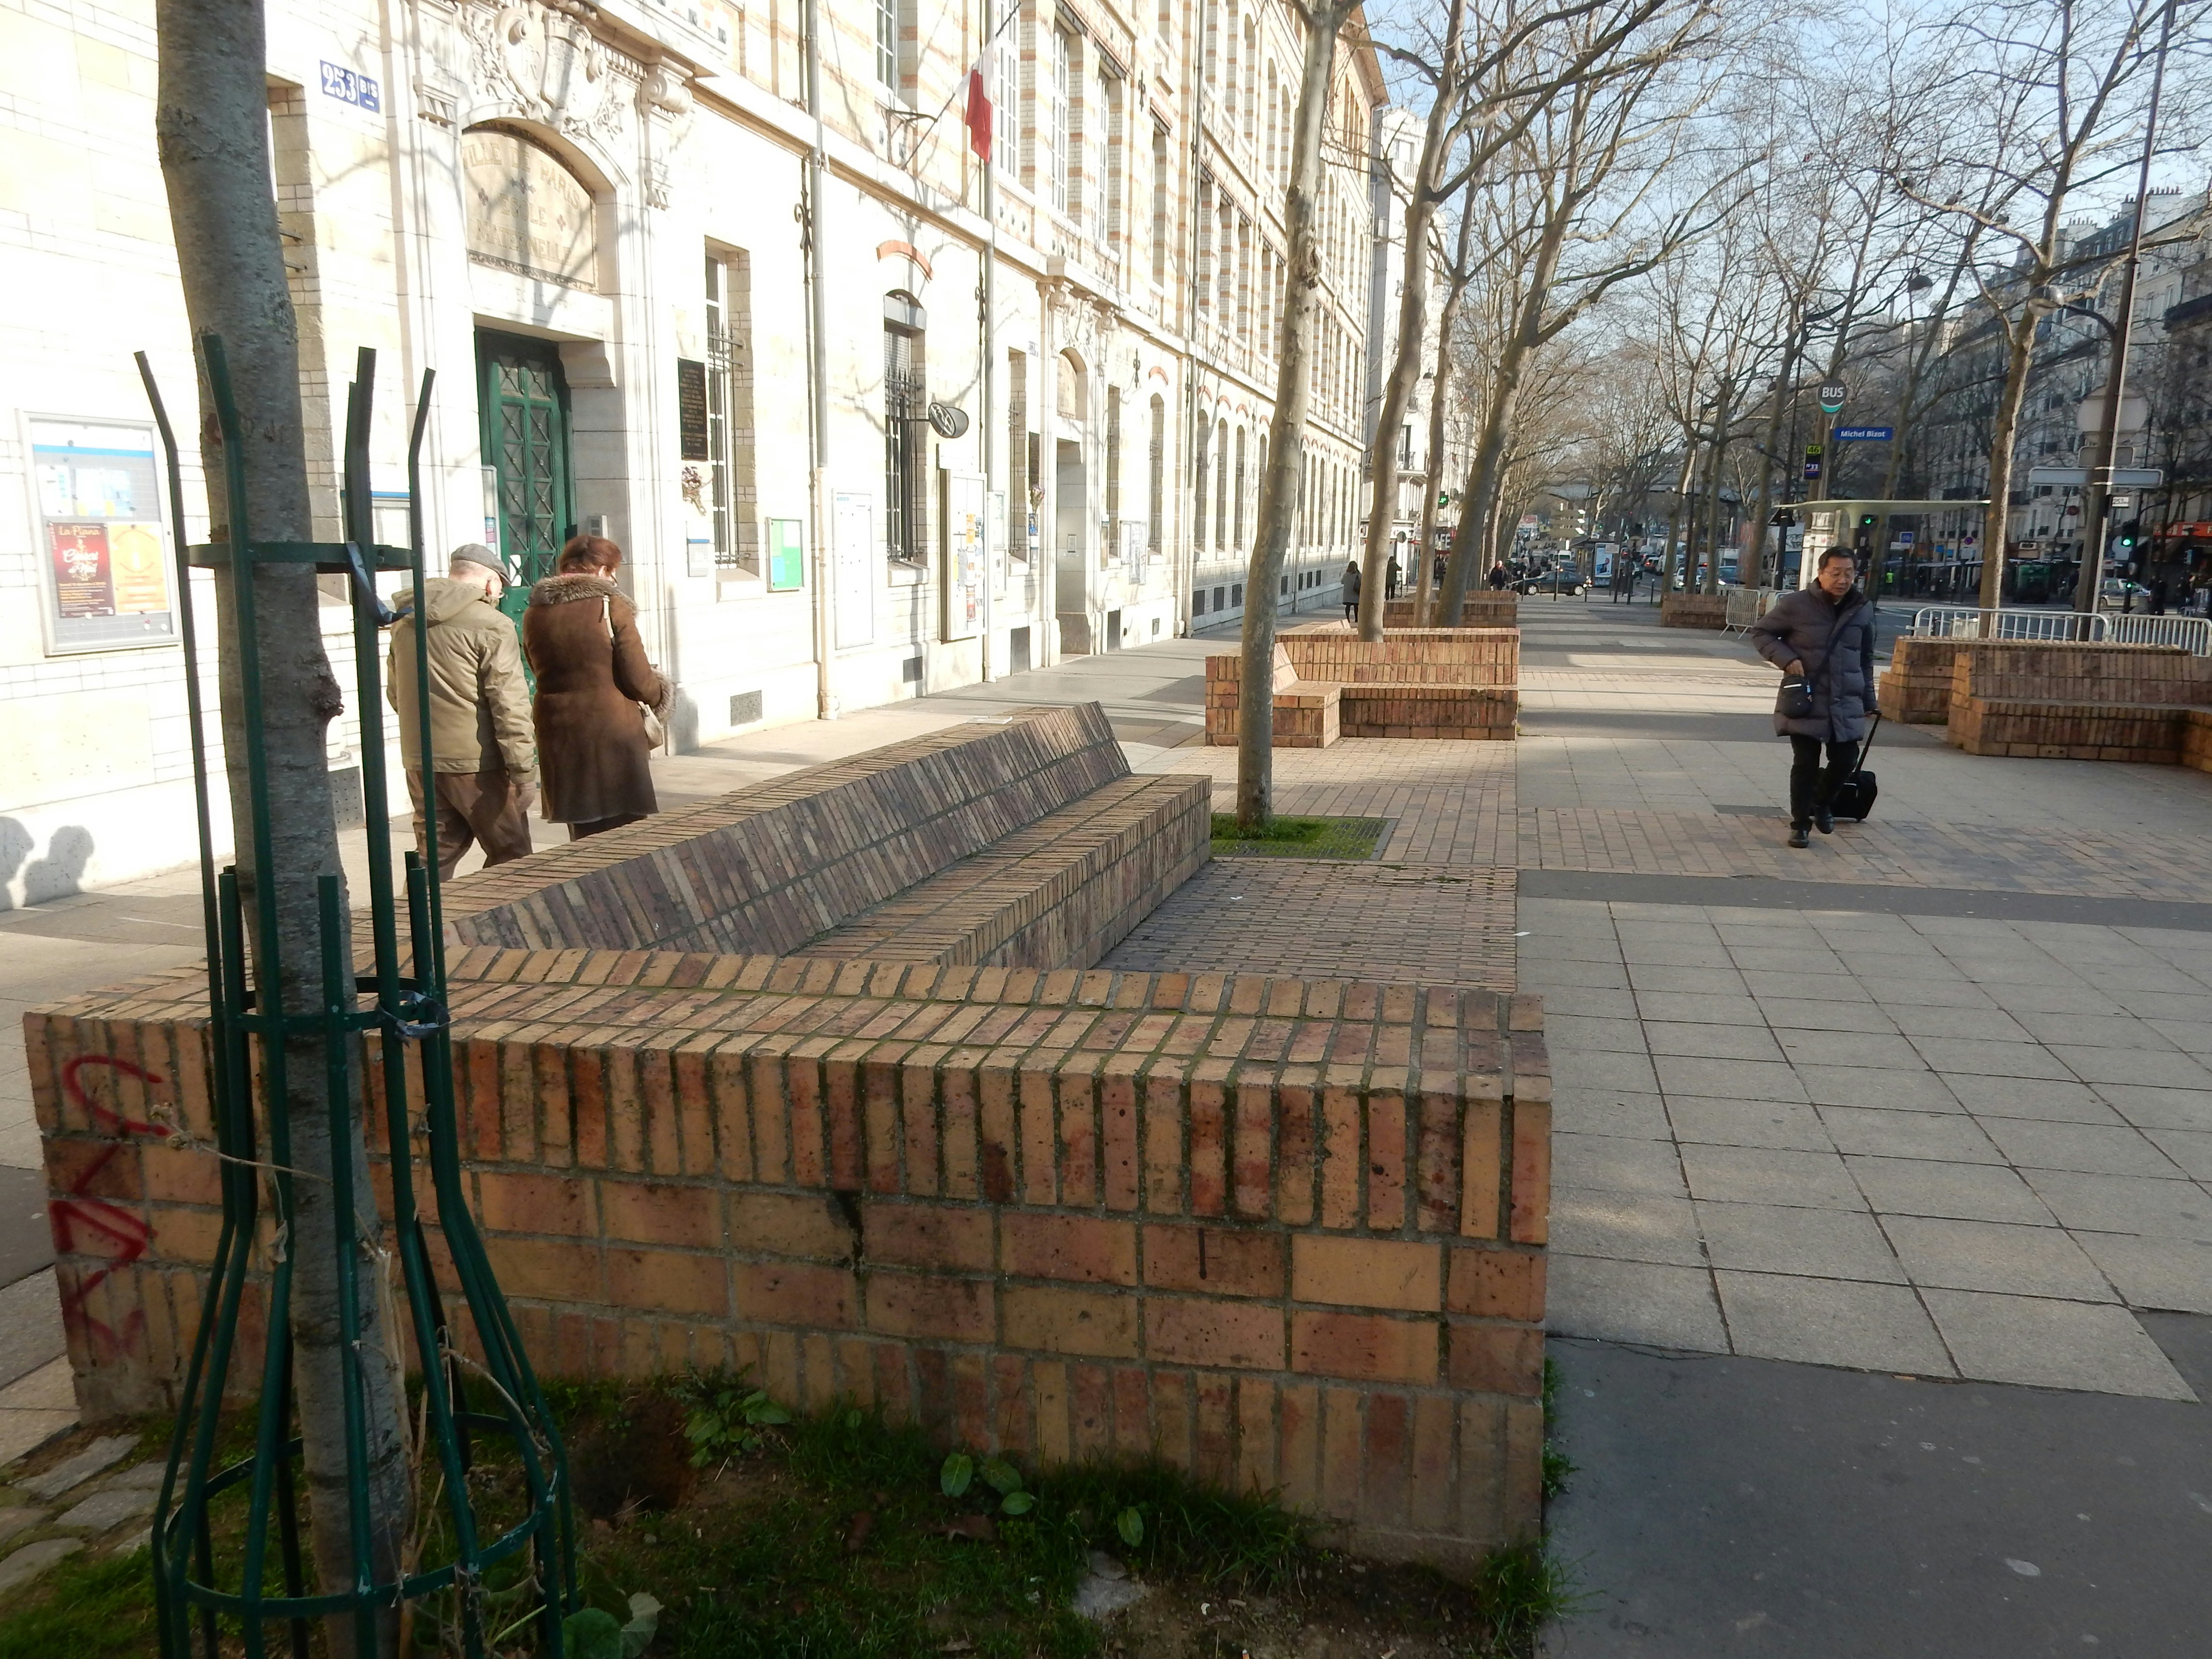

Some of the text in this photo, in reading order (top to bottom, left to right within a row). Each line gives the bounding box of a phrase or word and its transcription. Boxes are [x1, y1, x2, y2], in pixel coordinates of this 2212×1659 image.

[322, 63, 378, 102] 253 BIS
[510, 146, 531, 173] DE
[540, 159, 580, 210] PARIS
[499, 192, 548, 227] ECOLE
[476, 218, 572, 266] MATERNELLE
[1822, 387, 1844, 398] BUS
[59, 526, 72, 536] La
[1435, 533, 1451, 548] AFE
